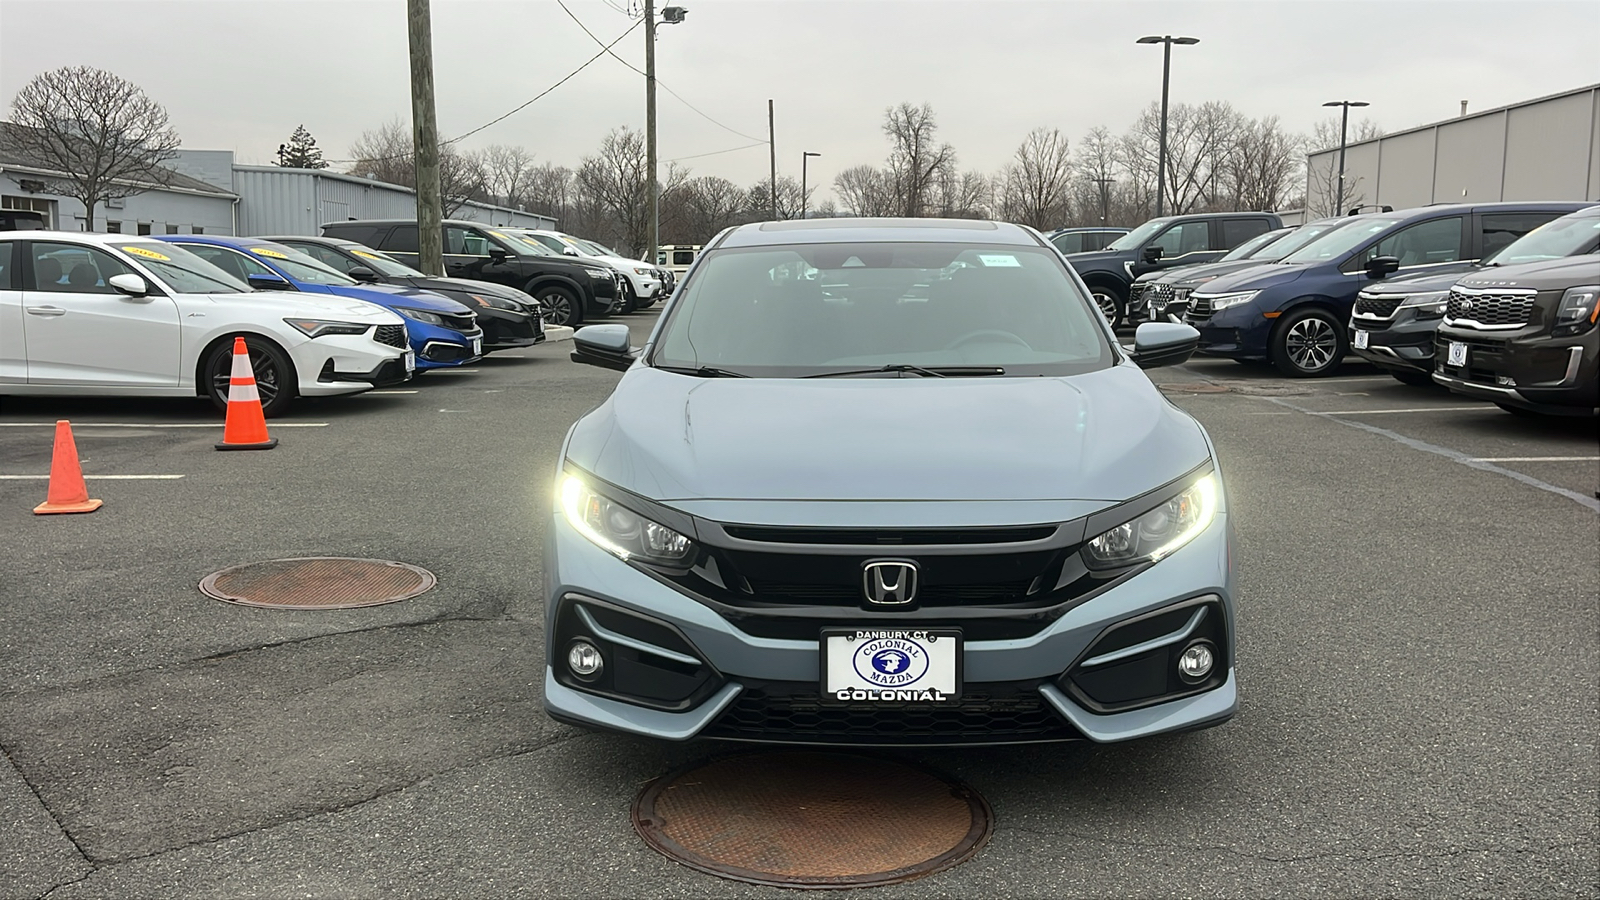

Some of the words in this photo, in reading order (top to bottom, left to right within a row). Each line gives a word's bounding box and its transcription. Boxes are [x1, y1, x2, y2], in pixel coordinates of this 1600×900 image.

[856, 631, 911, 639] DANBURY,
[913, 631, 929, 639] CT
[862, 640, 920, 659] COLONIAL
[870, 671, 914, 684] MAZDA
[836, 689, 947, 702] COLONIAL
